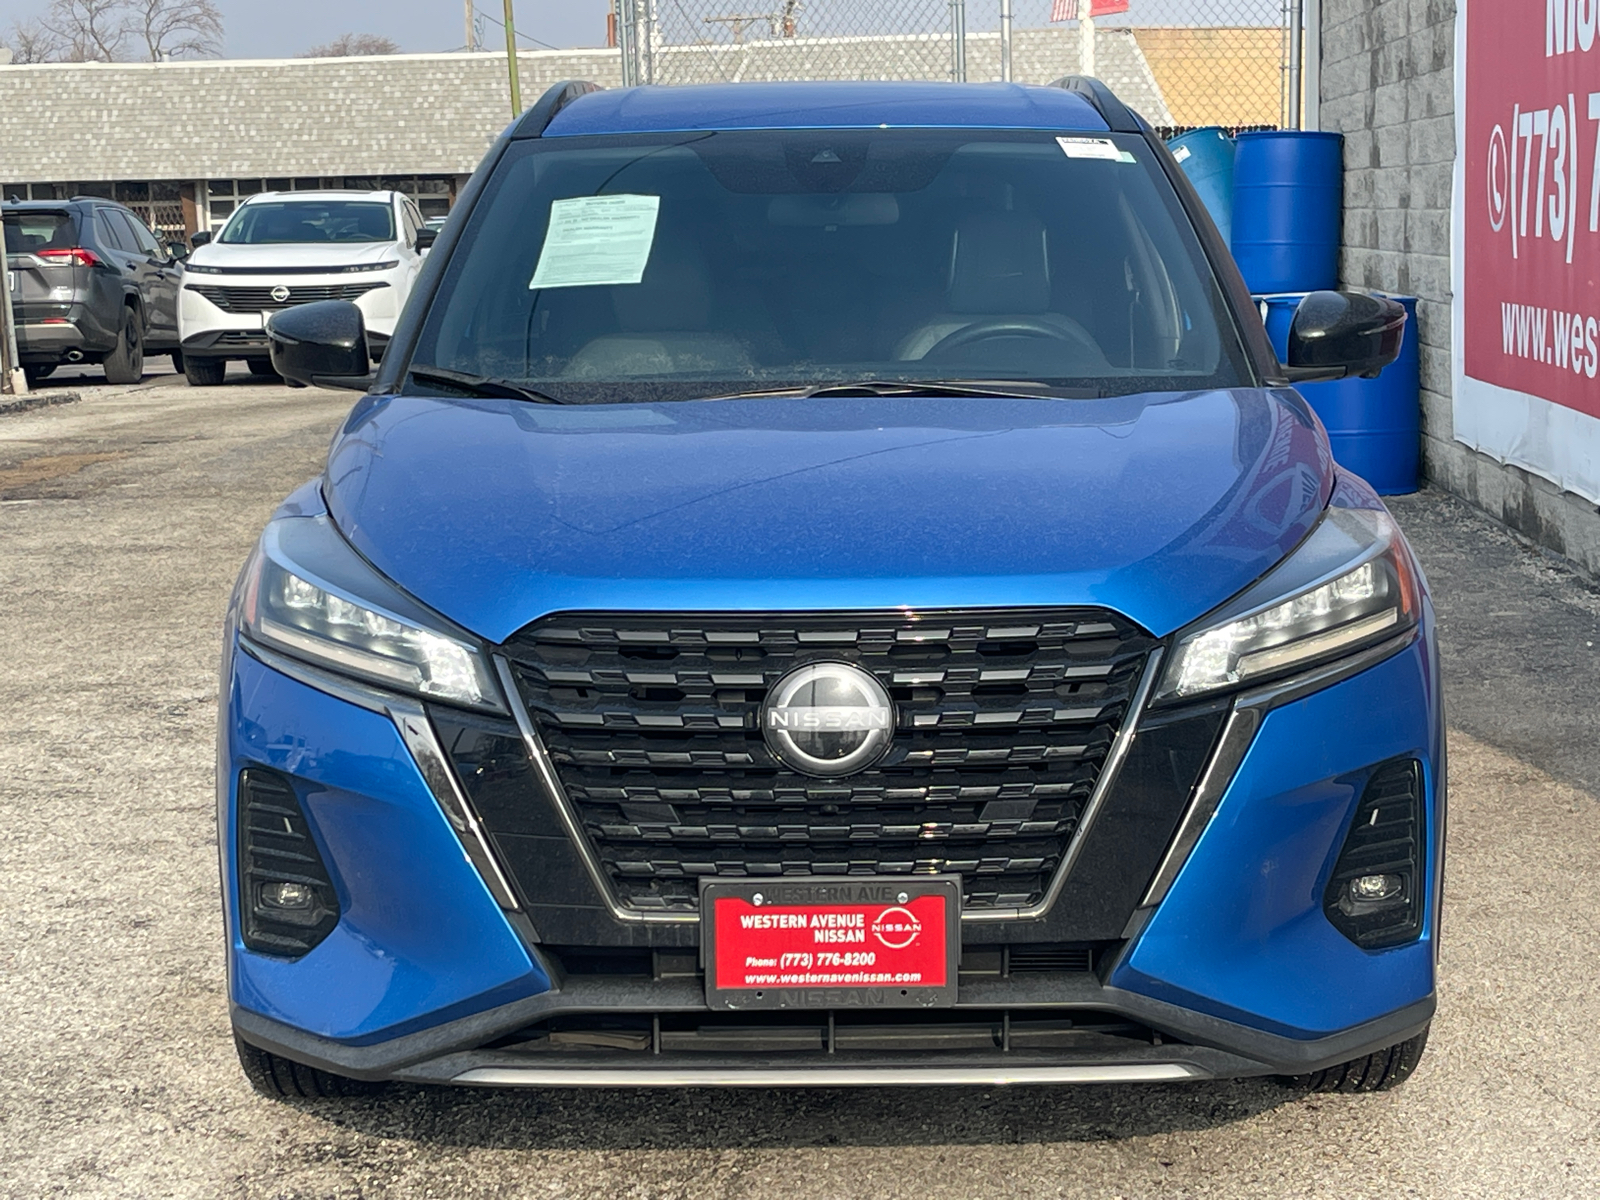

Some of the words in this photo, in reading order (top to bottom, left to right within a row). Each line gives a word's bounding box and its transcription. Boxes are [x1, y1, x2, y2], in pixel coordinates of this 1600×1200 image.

[1511, 93, 1577, 264] (773)
[771, 710, 887, 727] NISSAN
[765, 887, 852, 902] WESTERN
[740, 915, 808, 929] WESTERN
[810, 914, 865, 928] AVENUE
[872, 923, 922, 932] NISSAN
[814, 929, 865, 943] NISSAN
[746, 956, 777, 967] Phone:
[780, 952, 813, 970] (773)
[816, 952, 876, 967] 776-8200
[745, 971, 921, 984] www.westernavenissan.com
[780, 989, 885, 1007] NISSAN
